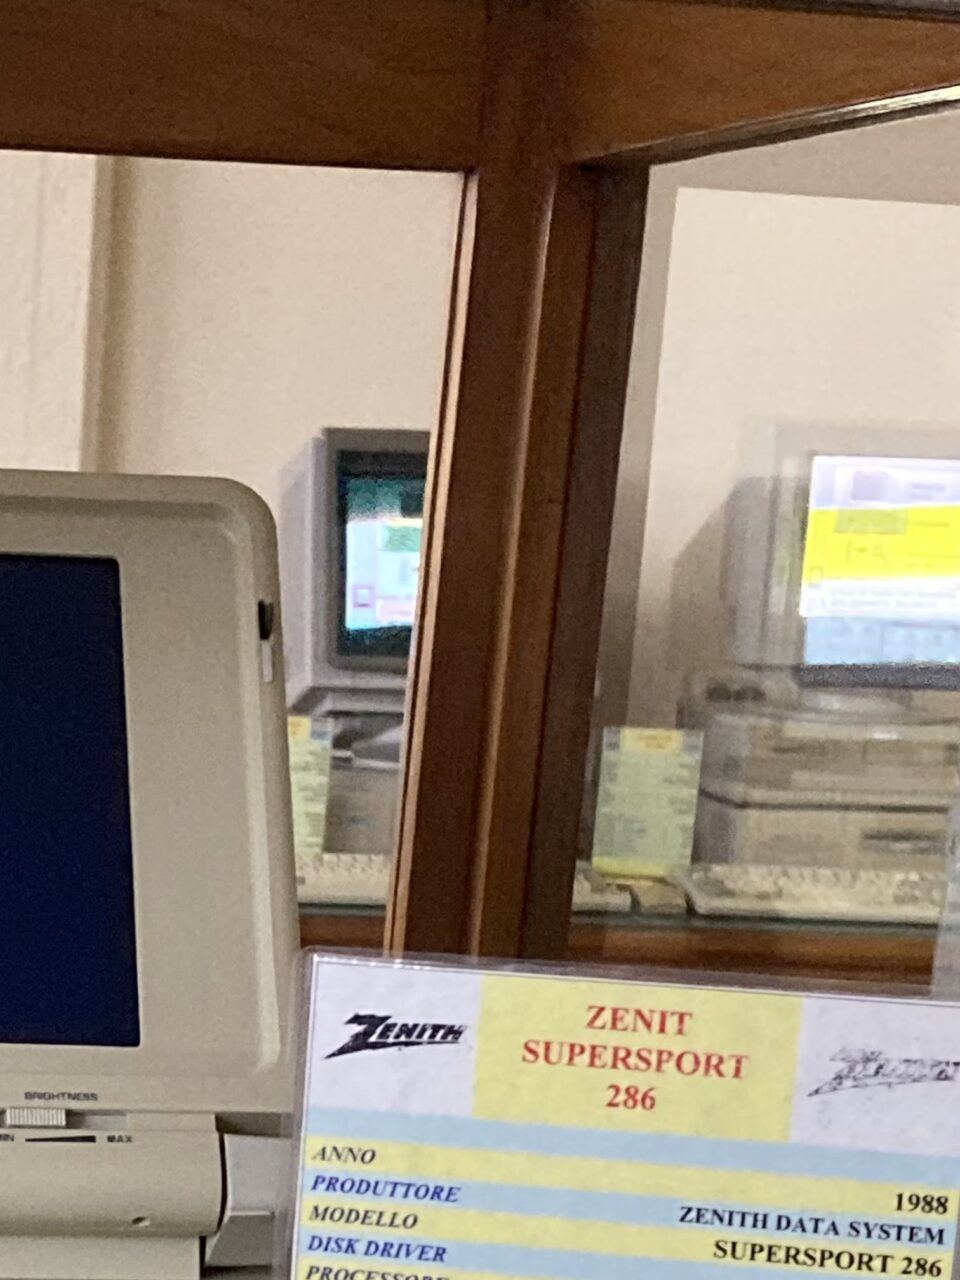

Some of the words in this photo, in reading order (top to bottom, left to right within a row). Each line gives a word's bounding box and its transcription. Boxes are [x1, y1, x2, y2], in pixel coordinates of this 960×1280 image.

[586, 1005, 693, 1036] ZENIT
[324, 1013, 464, 1059] ZENITH
[522, 1039, 749, 1079] SUPERSPORT
[24, 1092, 98, 1101] BRIGHTNESS
[606, 1084, 656, 1110] 286
[107, 1135, 133, 1143] MAX
[312, 1146, 376, 1164] ANNO
[311, 1175, 461, 1202] PRODUTTORE
[309, 1205, 418, 1229] MODELLO
[895, 1193, 948, 1215] 1988
[679, 1206, 769, 1230] ZENITH
[776, 1215, 840, 1236] DATA
[847, 1221, 945, 1245] SYSTEM
[308, 1235, 360, 1254] DISK
[364, 1240, 447, 1262] DRIVER
[713, 1240, 894, 1273] SUPERSPORT
[901, 1257, 942, 1277] 286
